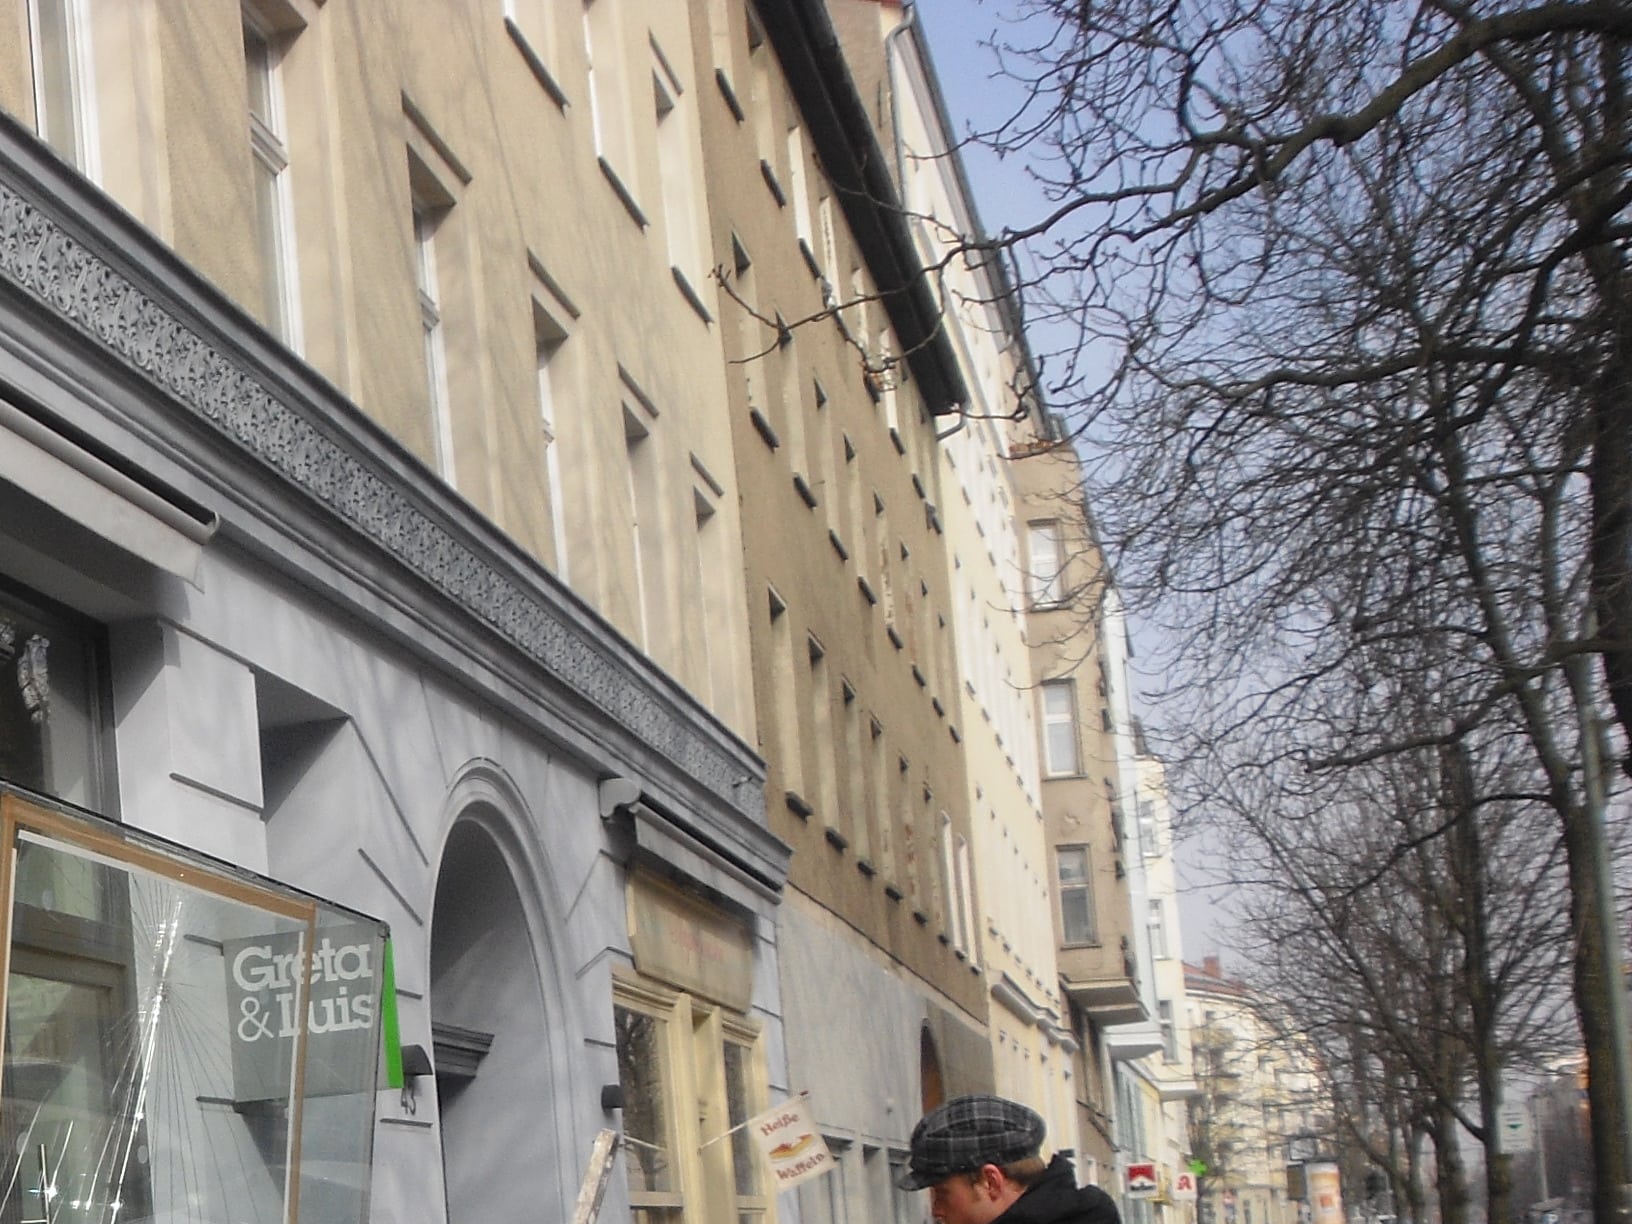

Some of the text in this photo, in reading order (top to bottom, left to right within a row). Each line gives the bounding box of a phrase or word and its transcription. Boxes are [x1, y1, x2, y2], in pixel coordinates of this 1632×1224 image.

[232, 938, 373, 991] Greta
[237, 986, 374, 1042] & Luis
[760, 1113, 799, 1136] Heiße
[776, 1152, 825, 1179] Waffeln
